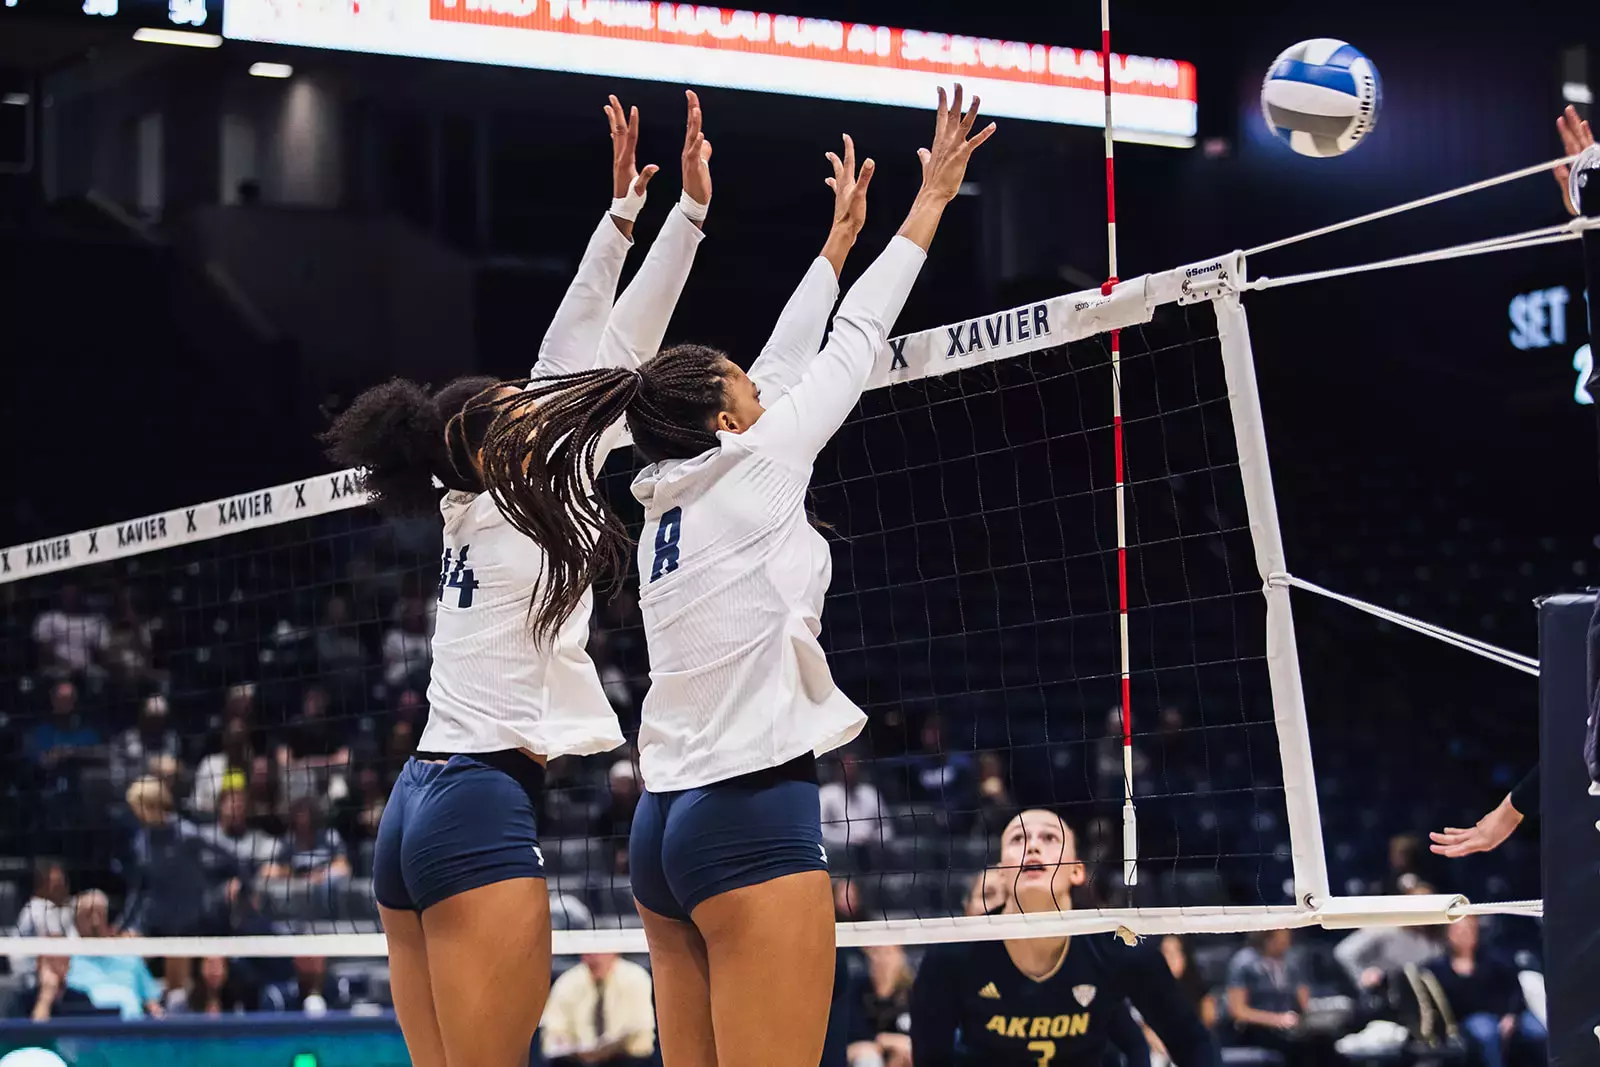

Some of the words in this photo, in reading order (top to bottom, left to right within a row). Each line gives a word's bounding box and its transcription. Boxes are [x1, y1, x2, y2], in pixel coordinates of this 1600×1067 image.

[890, 336, 908, 371] X
[946, 302, 1051, 358] XAVIER
[1508, 285, 1569, 350] SET
[2, 551, 11, 573] X
[27, 539, 71, 567] XAVIER
[88, 532, 99, 554] X
[117, 517, 167, 547] XAVIER
[186, 509, 197, 533] X
[218, 492, 272, 526] XAVIER
[294, 484, 306, 508] X
[649, 506, 682, 583] 8
[985, 1012, 1090, 1039] AKRON
